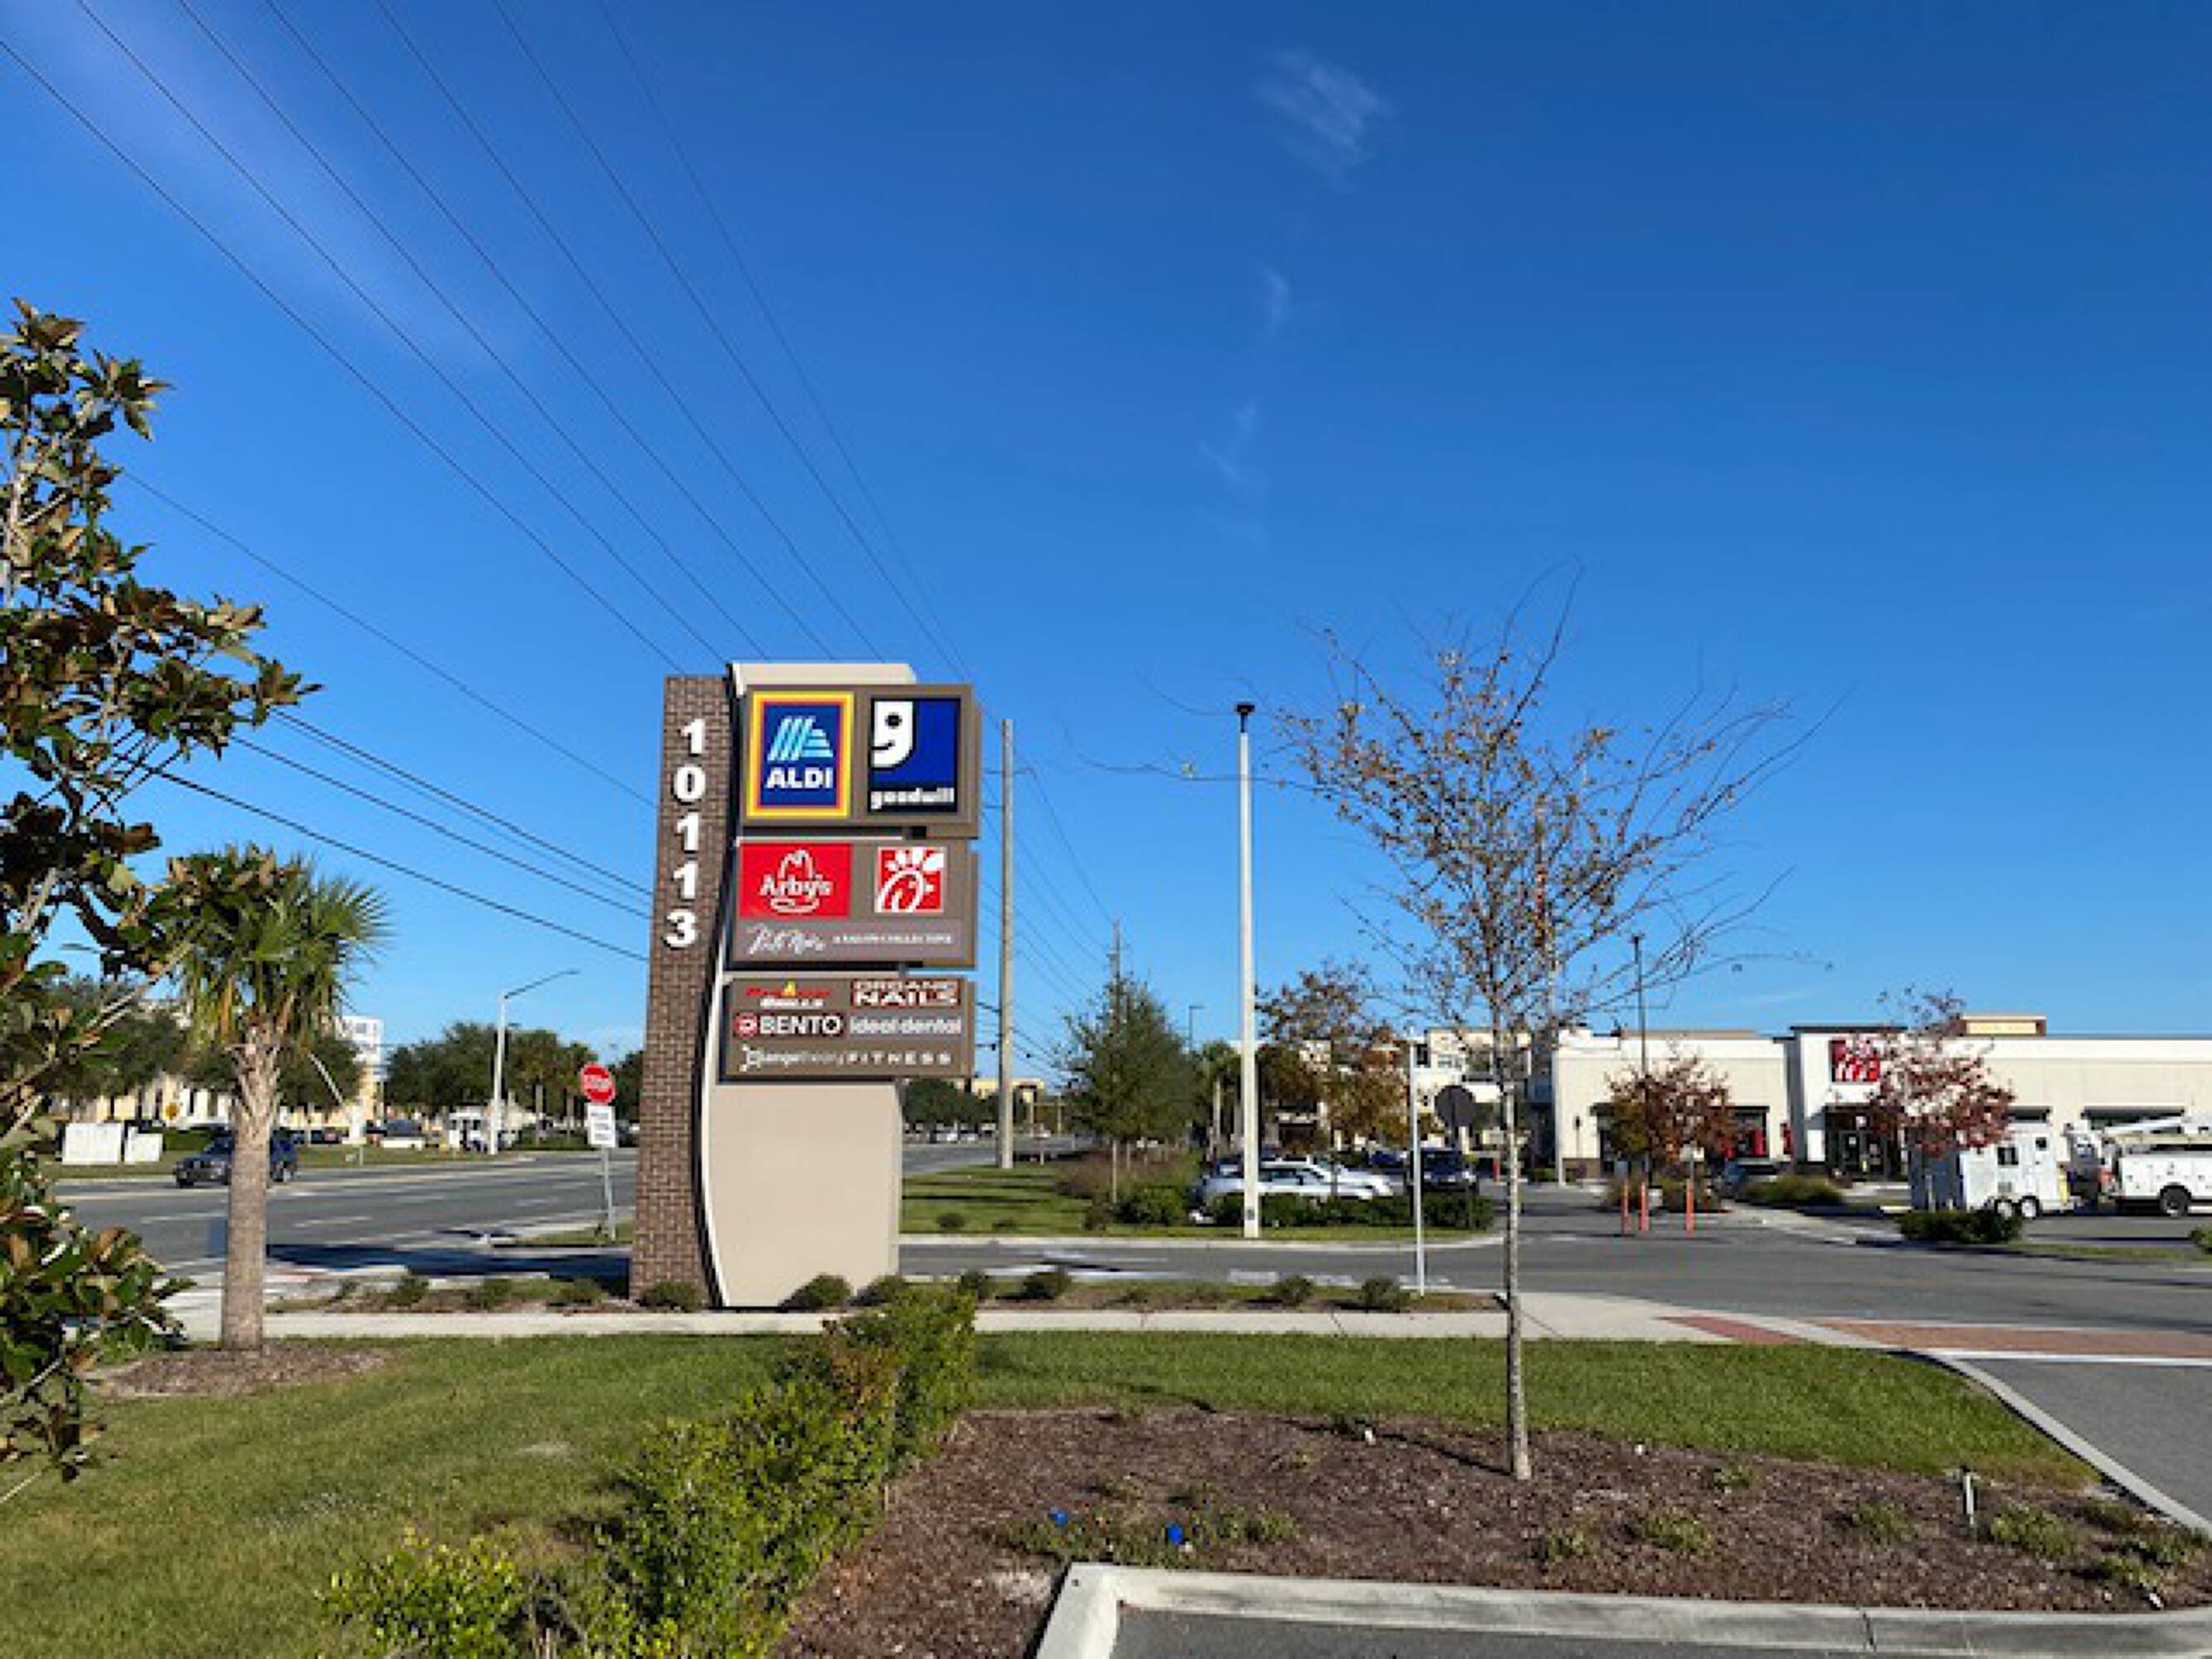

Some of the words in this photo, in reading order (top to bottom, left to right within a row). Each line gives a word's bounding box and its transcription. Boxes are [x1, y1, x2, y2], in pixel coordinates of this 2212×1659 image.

[765, 767, 833, 789] ALDI
[664, 718, 705, 947] 10113
[856, 990, 958, 1006] NAILS
[760, 1015, 841, 1034] BENTO
[848, 1050, 951, 1065] FITNESS
